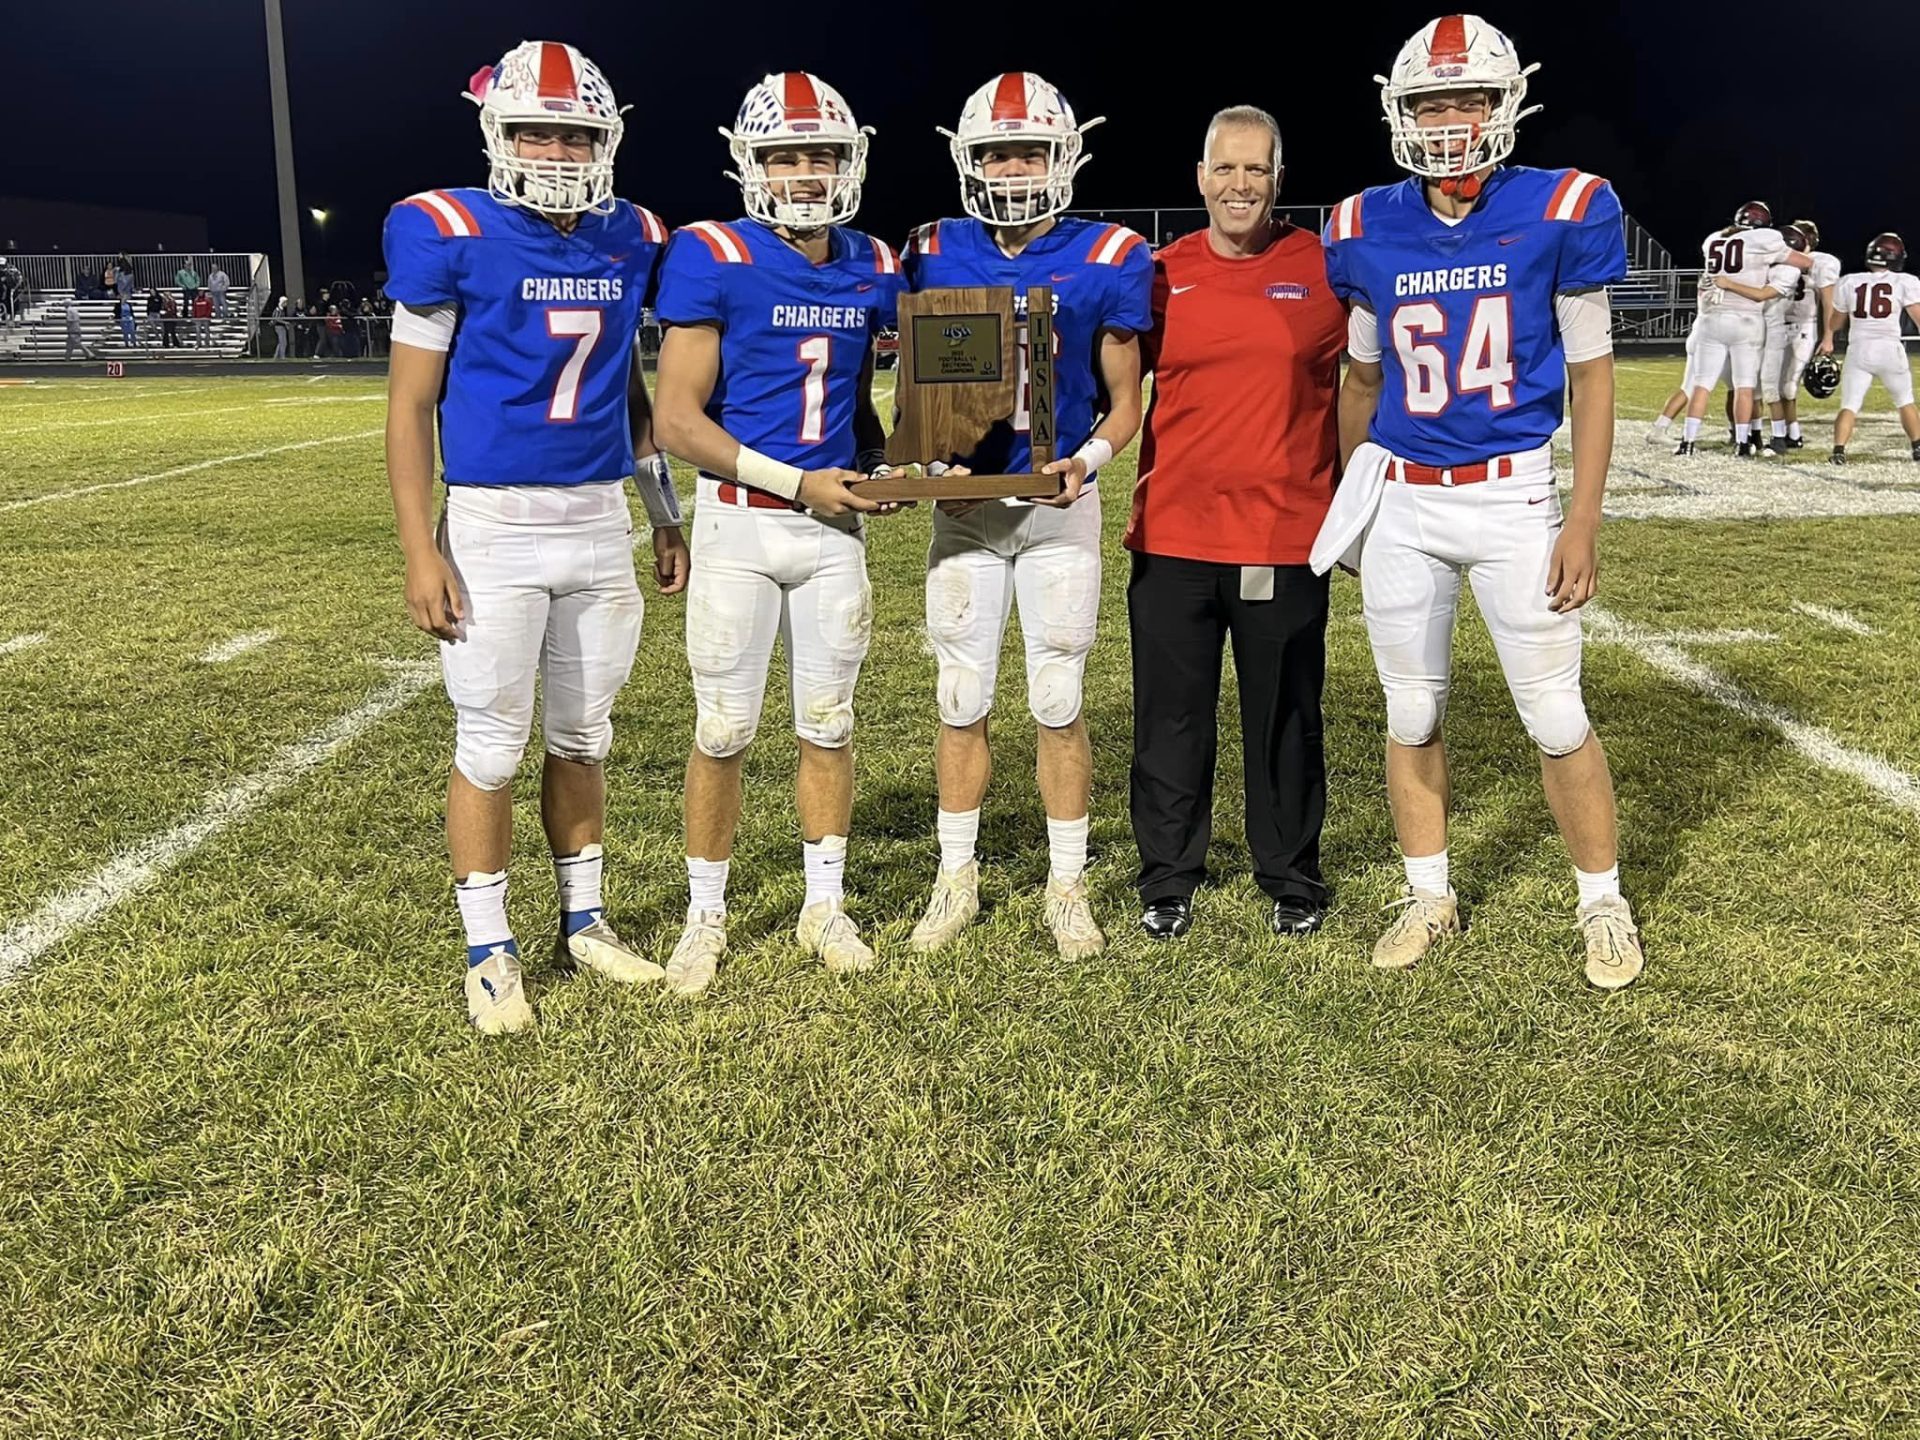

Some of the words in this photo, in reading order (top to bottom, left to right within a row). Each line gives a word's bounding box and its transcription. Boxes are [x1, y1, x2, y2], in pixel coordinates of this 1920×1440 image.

[1707, 238, 1744, 275] 50
[522, 277, 623, 301] CHARGERS
[1395, 263, 1508, 297] CHARGERS
[772, 304, 866, 329] CHARGERS
[1853, 282, 1893, 319] 16
[109, 364, 120, 375] 20
[545, 307, 604, 424] 7
[1390, 293, 1517, 418] 64
[797, 332, 834, 445] 1
[1033, 318, 1050, 441] IHSAA
